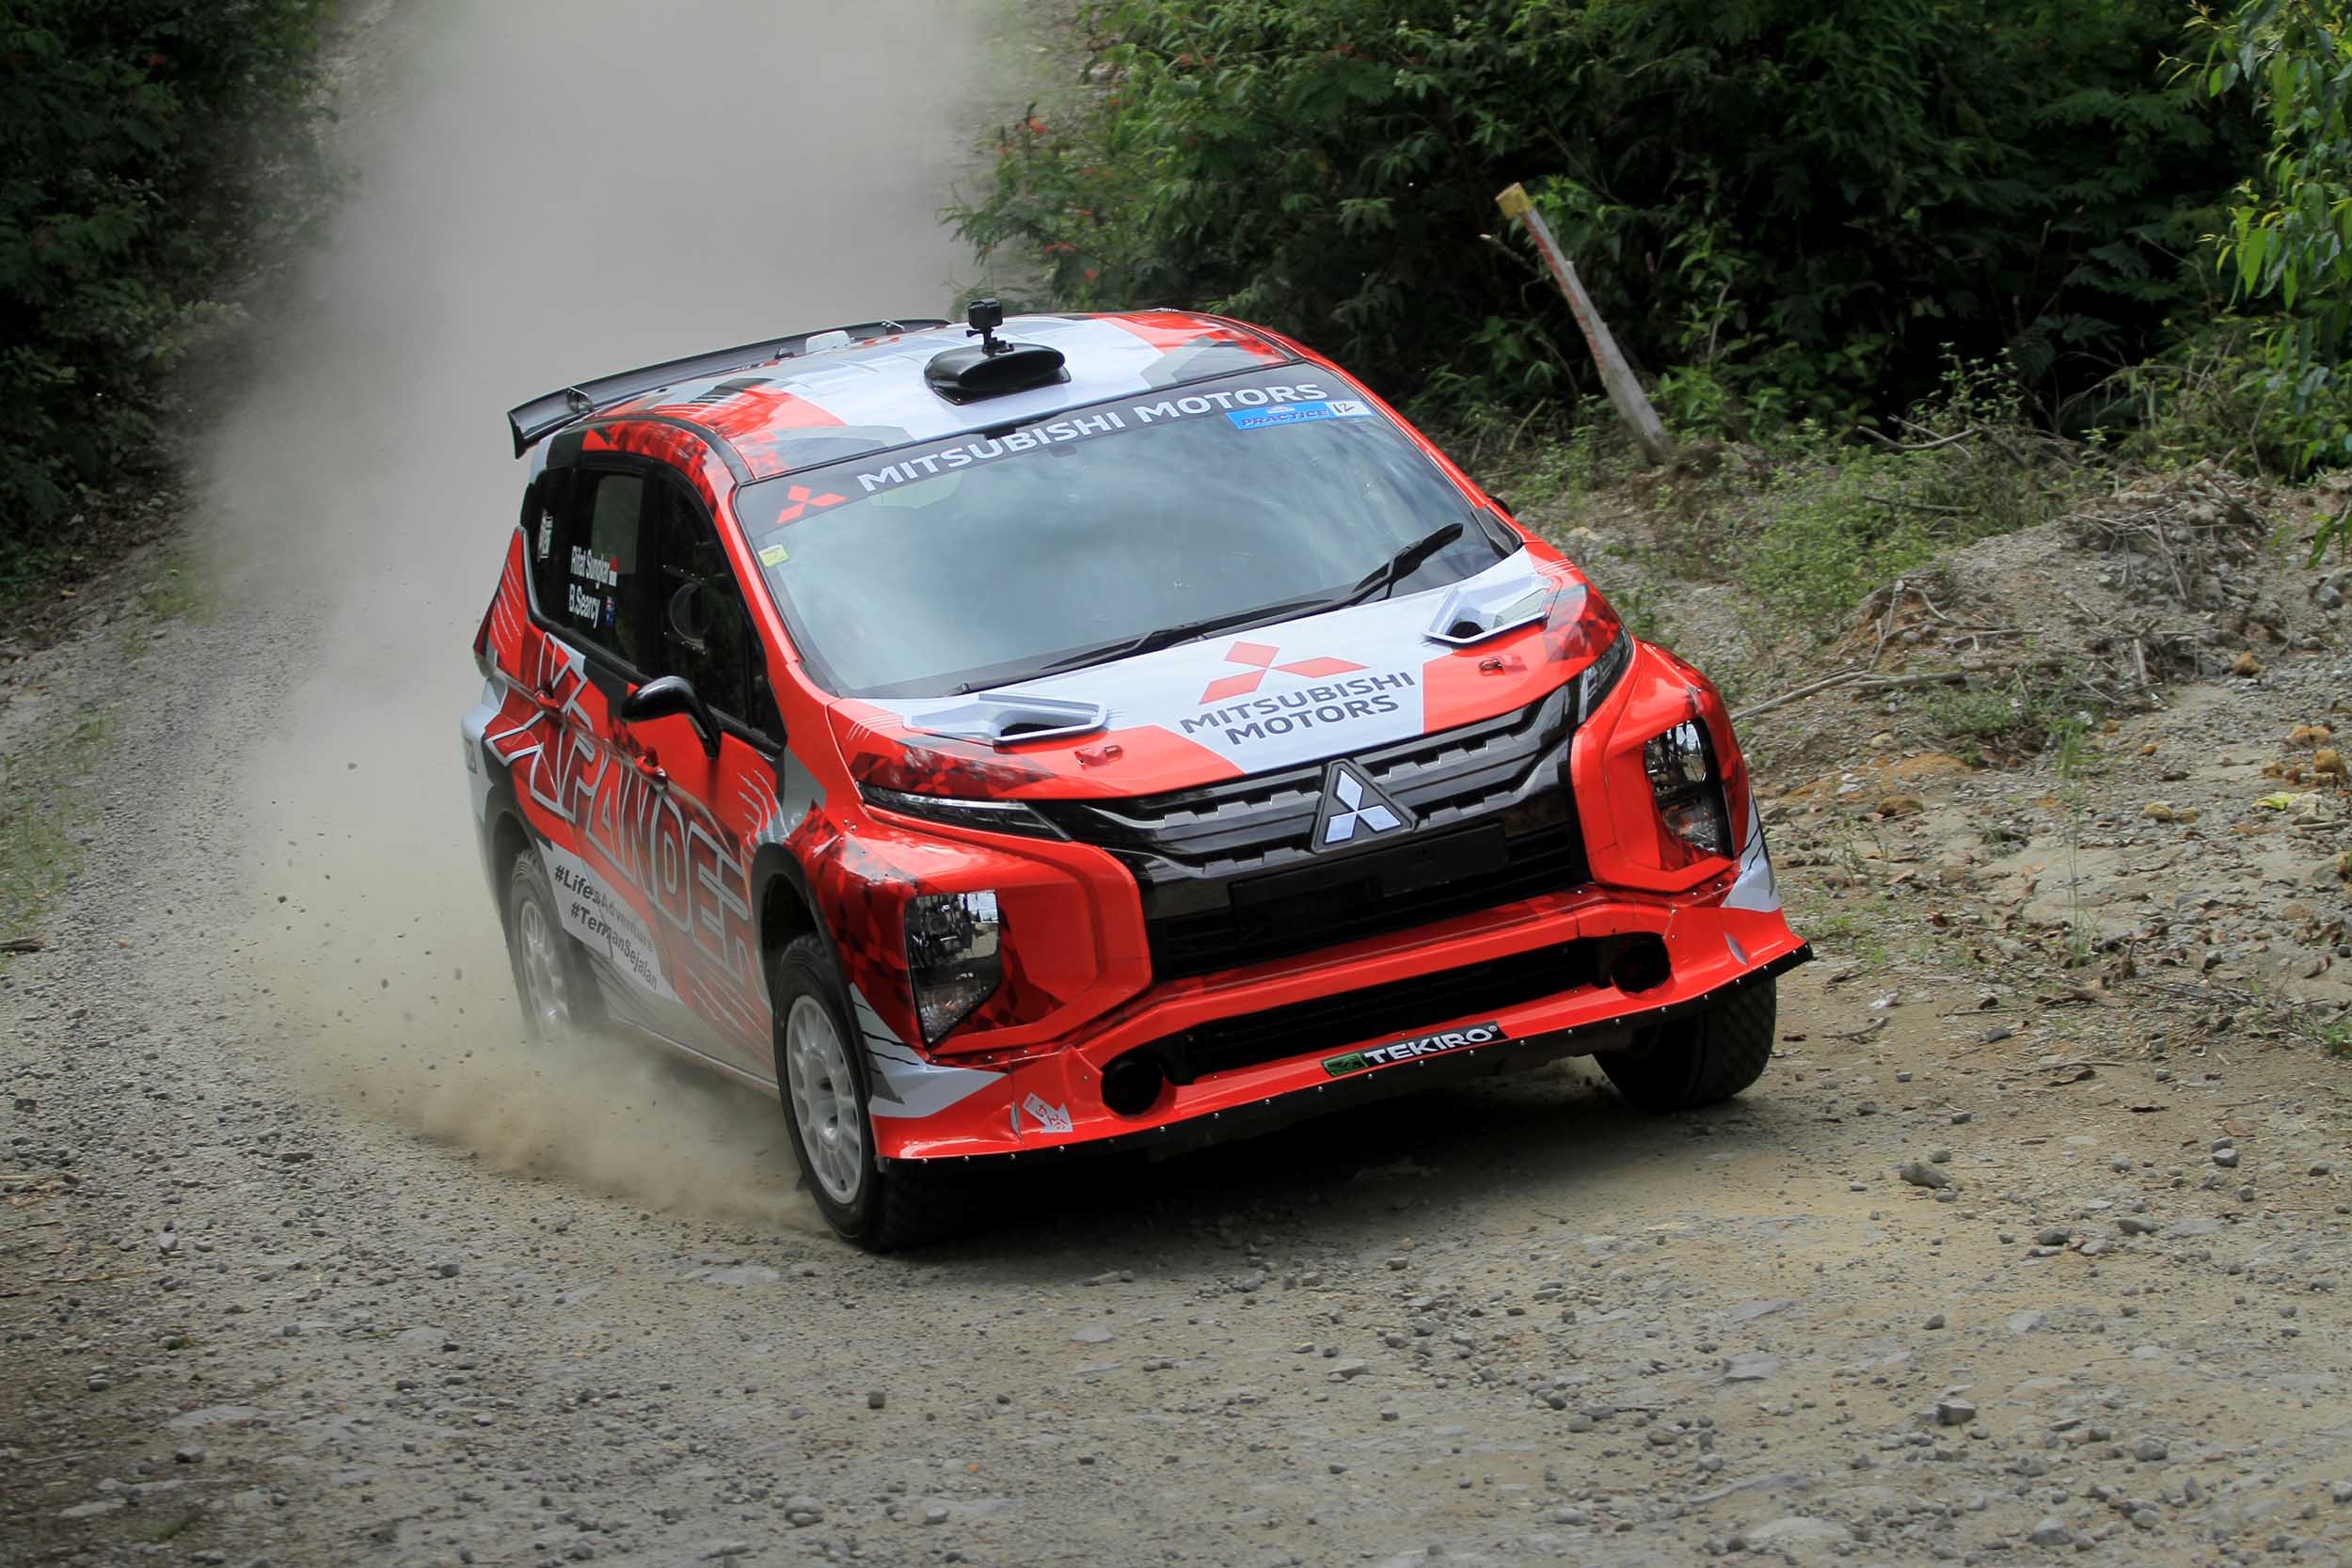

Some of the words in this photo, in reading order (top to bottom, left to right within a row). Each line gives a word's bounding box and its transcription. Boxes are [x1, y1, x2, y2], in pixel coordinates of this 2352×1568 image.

[1241, 408, 1329, 427] PRACTICE
[1333, 402, 1355, 414] 12
[857, 411, 1126, 492] MITSUBISHI
[1134, 383, 1328, 423] MOTORS
[1179, 671, 1416, 735] MITSUBISHI
[1227, 694, 1400, 745] MOTORS
